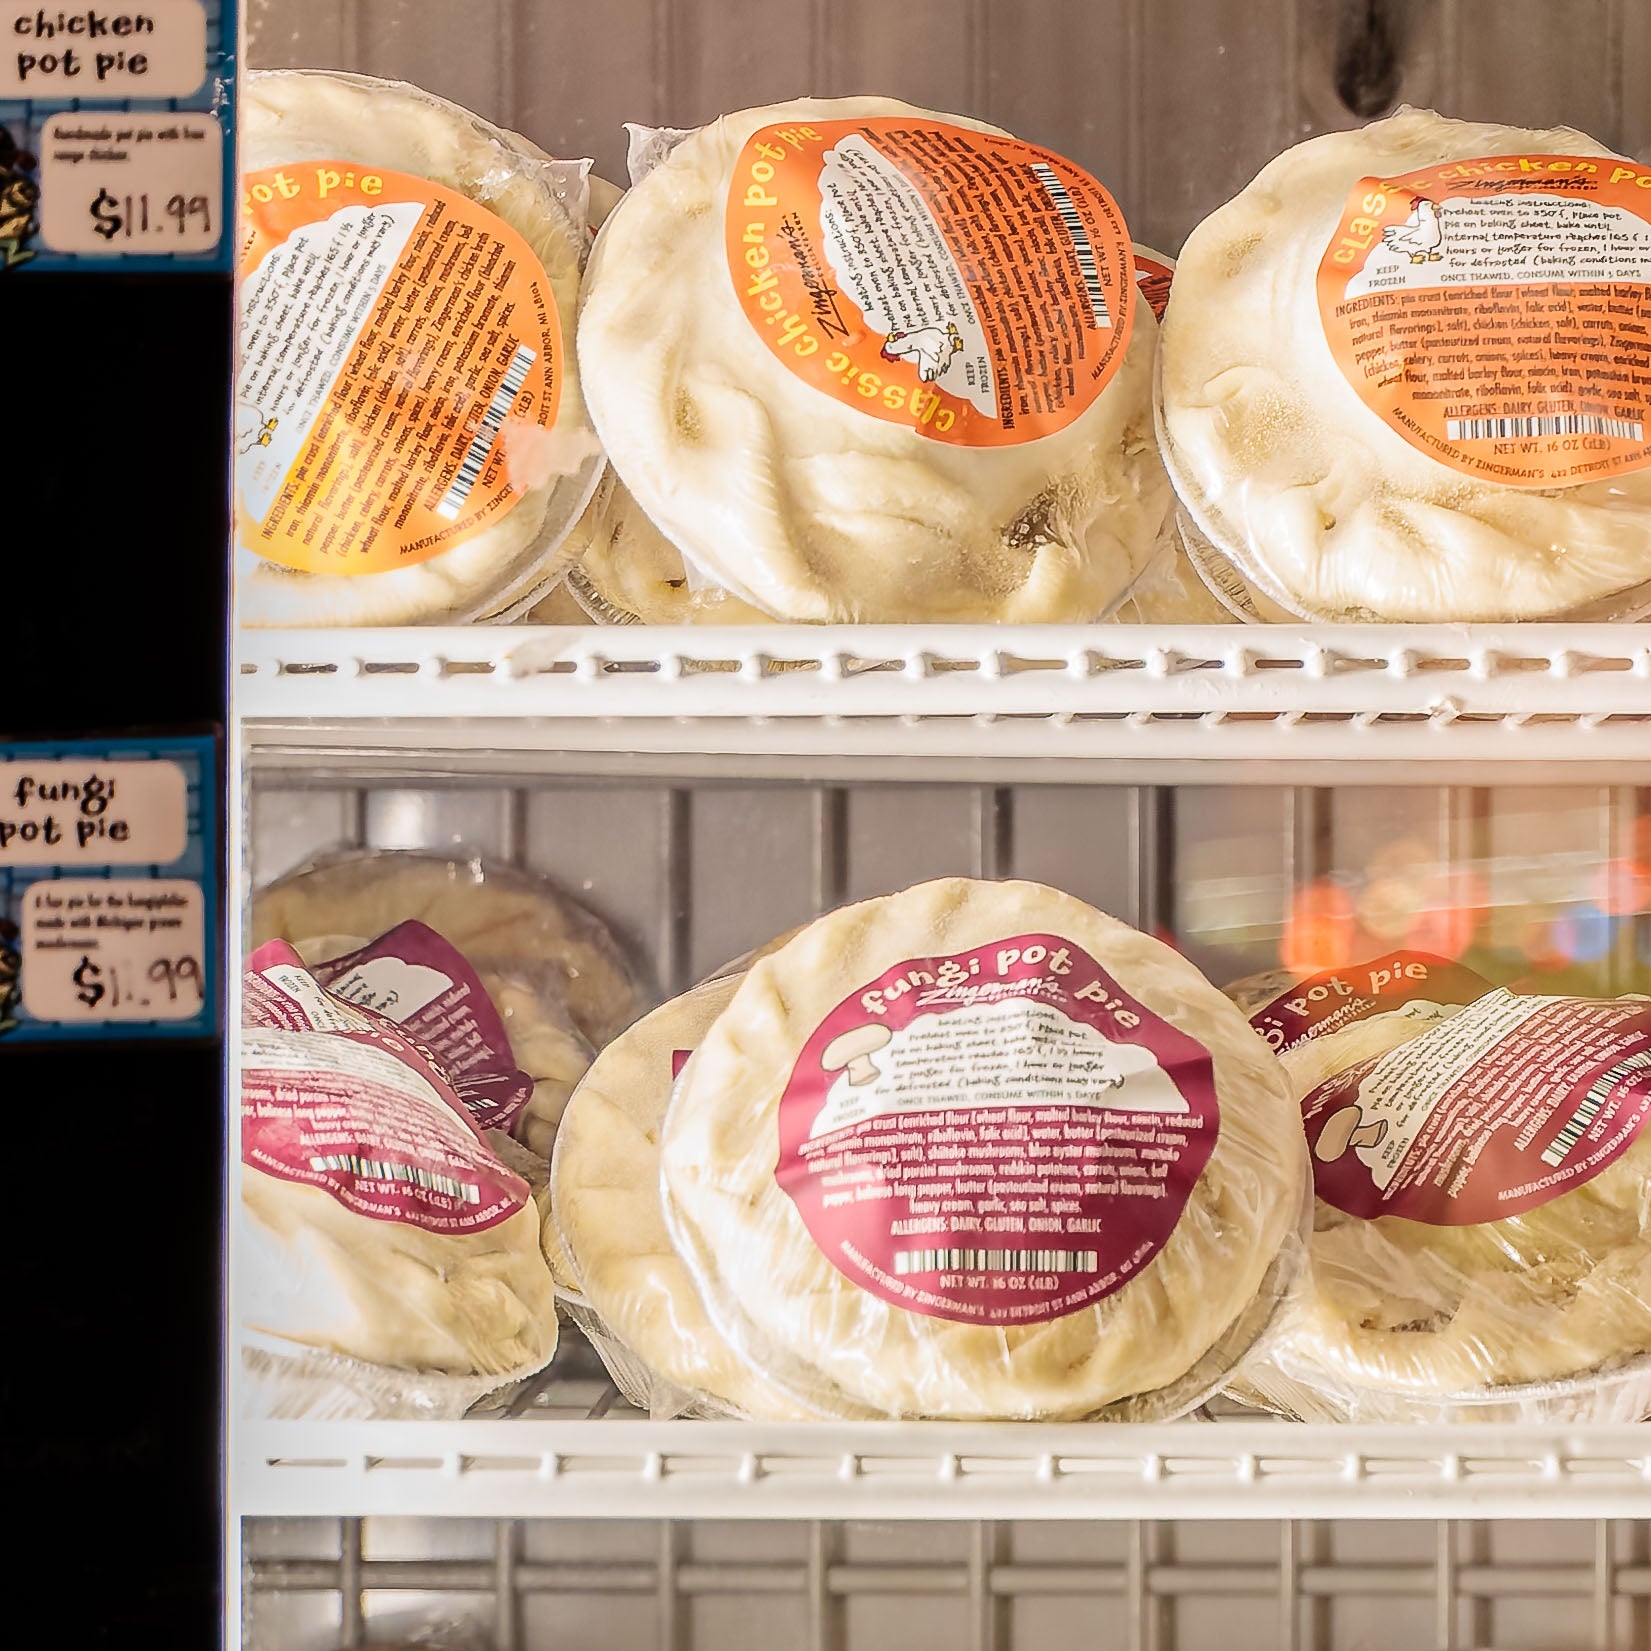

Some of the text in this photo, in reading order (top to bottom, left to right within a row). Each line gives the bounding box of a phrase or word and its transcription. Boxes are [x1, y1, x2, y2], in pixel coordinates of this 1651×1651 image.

[14, 8, 154, 38] chicken
[17, 49, 148, 81] pot pie
[774, 124, 824, 152] pie
[318, 169, 384, 198] pie
[744, 139, 786, 206] pot
[1438, 159, 1600, 181] chicken
[90, 188, 211, 240] $11.99
[742, 221, 819, 357] chicken
[14, 774, 116, 816] fungi
[0, 815, 131, 848] pot pie
[860, 944, 1141, 1030] fungi pot pie
[1285, 960, 1429, 1018] pot pie
